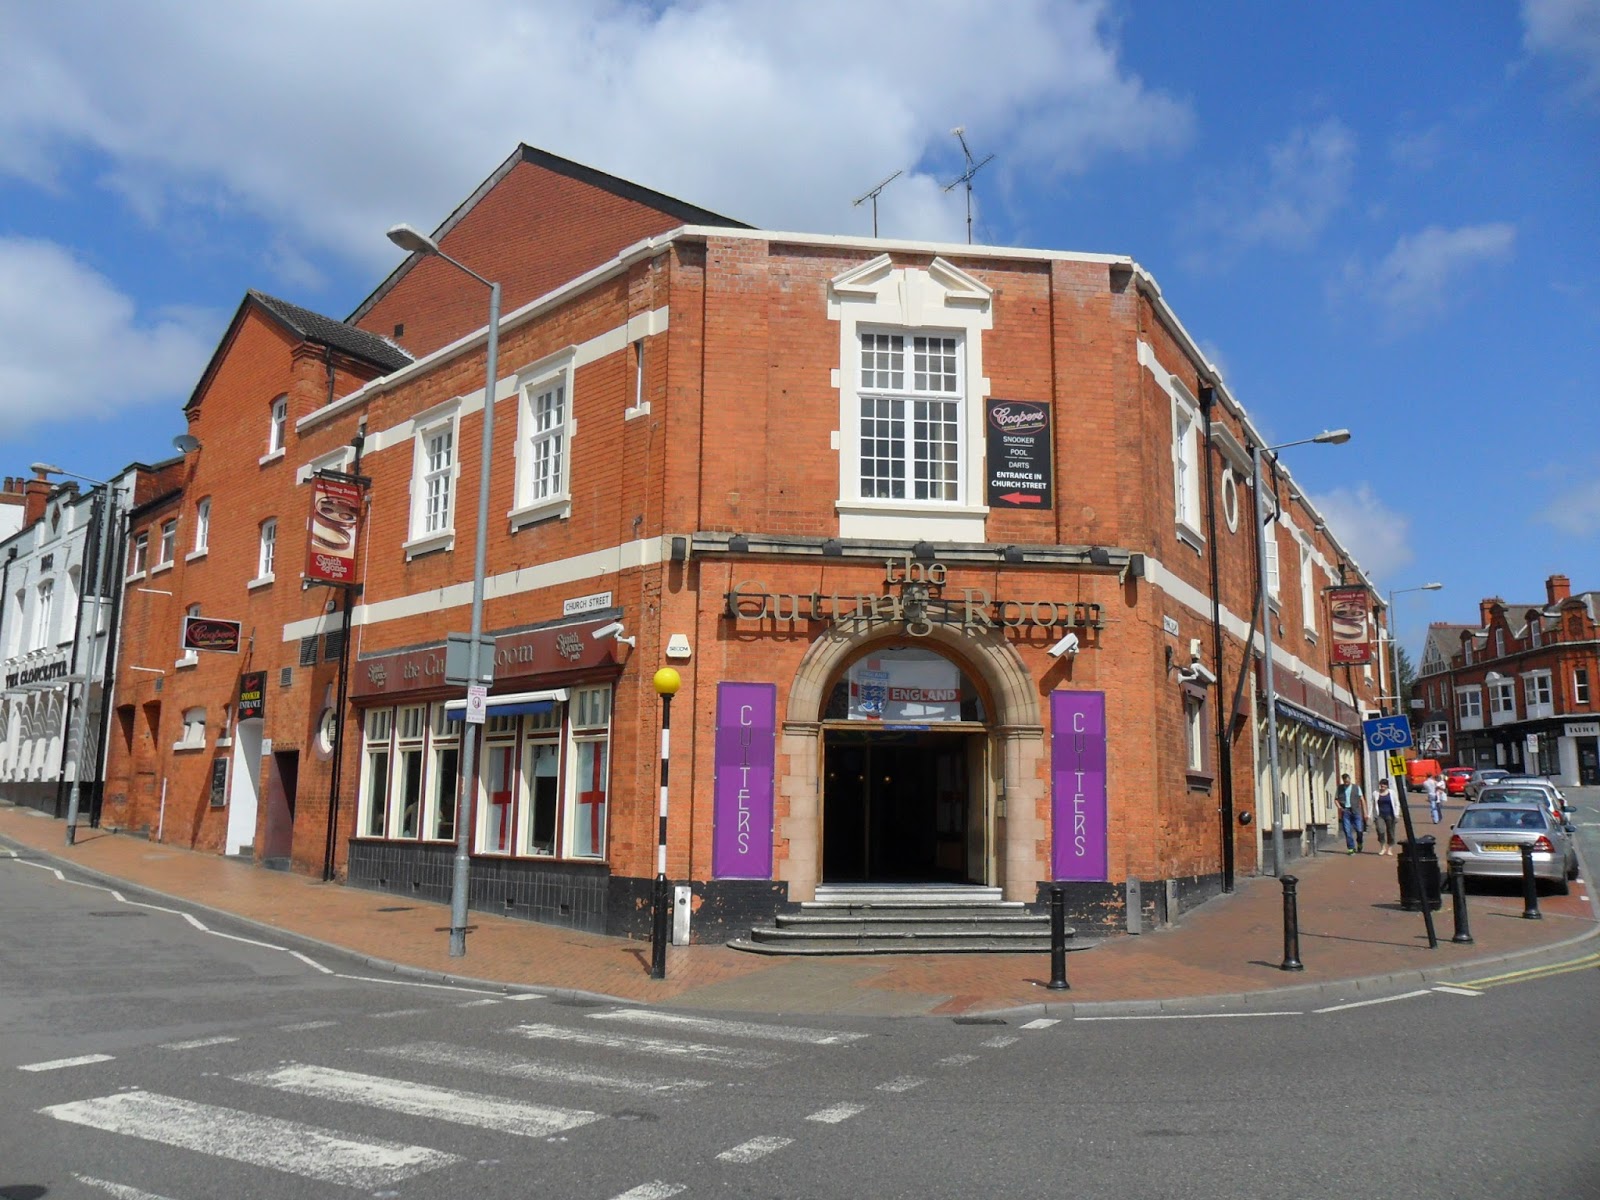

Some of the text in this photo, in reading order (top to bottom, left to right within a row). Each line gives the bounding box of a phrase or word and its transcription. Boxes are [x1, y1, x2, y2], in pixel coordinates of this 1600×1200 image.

[993, 407, 1044, 428] Coopers
[1003, 436, 1035, 444] SNOOKER
[1010, 448, 1028, 456] POOL
[1008, 461, 1030, 469] DARTS
[996, 471, 1033, 480] ENTRANCE
[991, 480, 1047, 490] CHURCH STREET
[315, 554, 341, 567] Smith
[885, 553, 947, 585] the
[565, 595, 609, 611] CHURCH STREET
[729, 579, 1108, 637] Cutting Room
[556, 632, 579, 650] Smith
[567, 642, 584, 653] Jones
[404, 661, 420, 679] the
[494, 644, 533, 667] oom
[892, 688, 957, 701] ENGLAND
[1390, 757, 1404, 774] H
